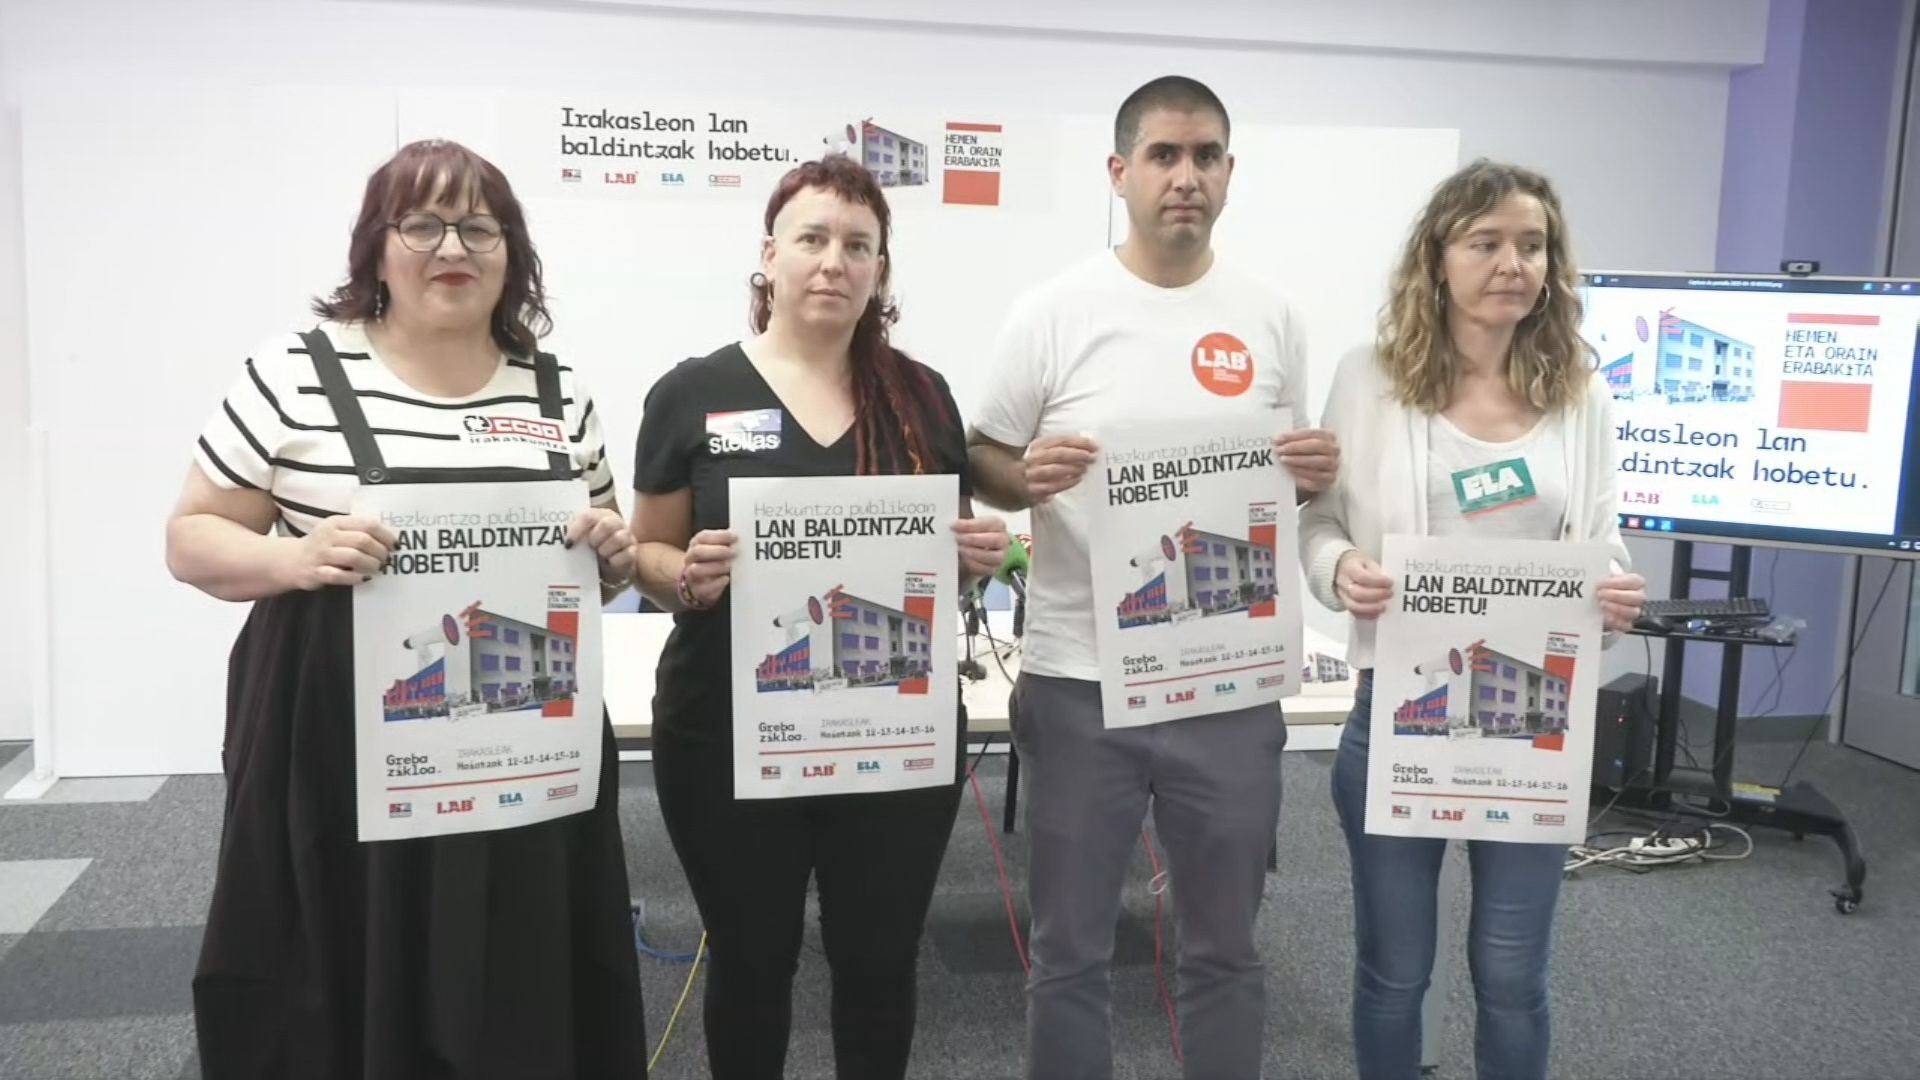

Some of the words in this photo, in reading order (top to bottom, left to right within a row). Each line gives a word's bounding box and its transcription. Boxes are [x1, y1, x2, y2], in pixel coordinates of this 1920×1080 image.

[562, 108, 695, 132] Irakasleon
[708, 113, 748, 133] lan
[945, 134, 977, 145] HEMEN
[562, 135, 695, 160] baldintzak
[708, 140, 799, 163] hobetu.
[945, 145, 964, 155] ETA
[970, 146, 1002, 157] ORAIN
[605, 172, 638, 185] LAB
[661, 173, 685, 183] ELA
[1785, 330, 1838, 343] HEMEN
[1197, 347, 1248, 371] LAB
[1784, 346, 1815, 358] ETA
[1825, 347, 1878, 361] ORAIN
[1616, 420, 1738, 448] akasleon
[1756, 428, 1807, 452] lan
[1105, 447, 1188, 465] Hezkuntza
[1193, 435, 1273, 457] publikoan
[1108, 464, 1145, 486] LAN
[1153, 448, 1274, 480] BALDINTZAK
[1619, 452, 1736, 480] dintzak
[1753, 459, 1868, 489] hobetu.
[1461, 466, 1524, 500] ELA
[1109, 479, 1189, 506] HOBETU!
[1623, 491, 1660, 505] LAB
[754, 502, 843, 516] Hezkuntza
[850, 500, 936, 518] publikoan
[380, 511, 480, 527] Hezkuntza
[755, 519, 795, 538] LAN
[805, 516, 935, 537] BALDINTZAK
[399, 529, 427, 550] AN
[756, 540, 842, 560] HOBETU!
[383, 552, 479, 575] HOBETU!
[1405, 558, 1492, 574] Hezkuntza
[1497, 561, 1586, 579] publikoan
[1404, 574, 1443, 593] LAN
[1453, 576, 1584, 598] BALDINTZAK
[1402, 595, 1488, 615] HOBETU!
[1122, 654, 1157, 666] Greba
[1215, 682, 1236, 693] ELA
[1166, 691, 1196, 704] LAB
[759, 722, 795, 733] Greba
[386, 754, 428, 766] Greba
[857, 761, 880, 771] ELA
[802, 765, 835, 778] LAB
[1393, 763, 1428, 775] Greba
[499, 793, 524, 804] ELA
[437, 800, 474, 814] LAB
[1432, 810, 1464, 821] LAB
[1486, 810, 1510, 820] ELA
